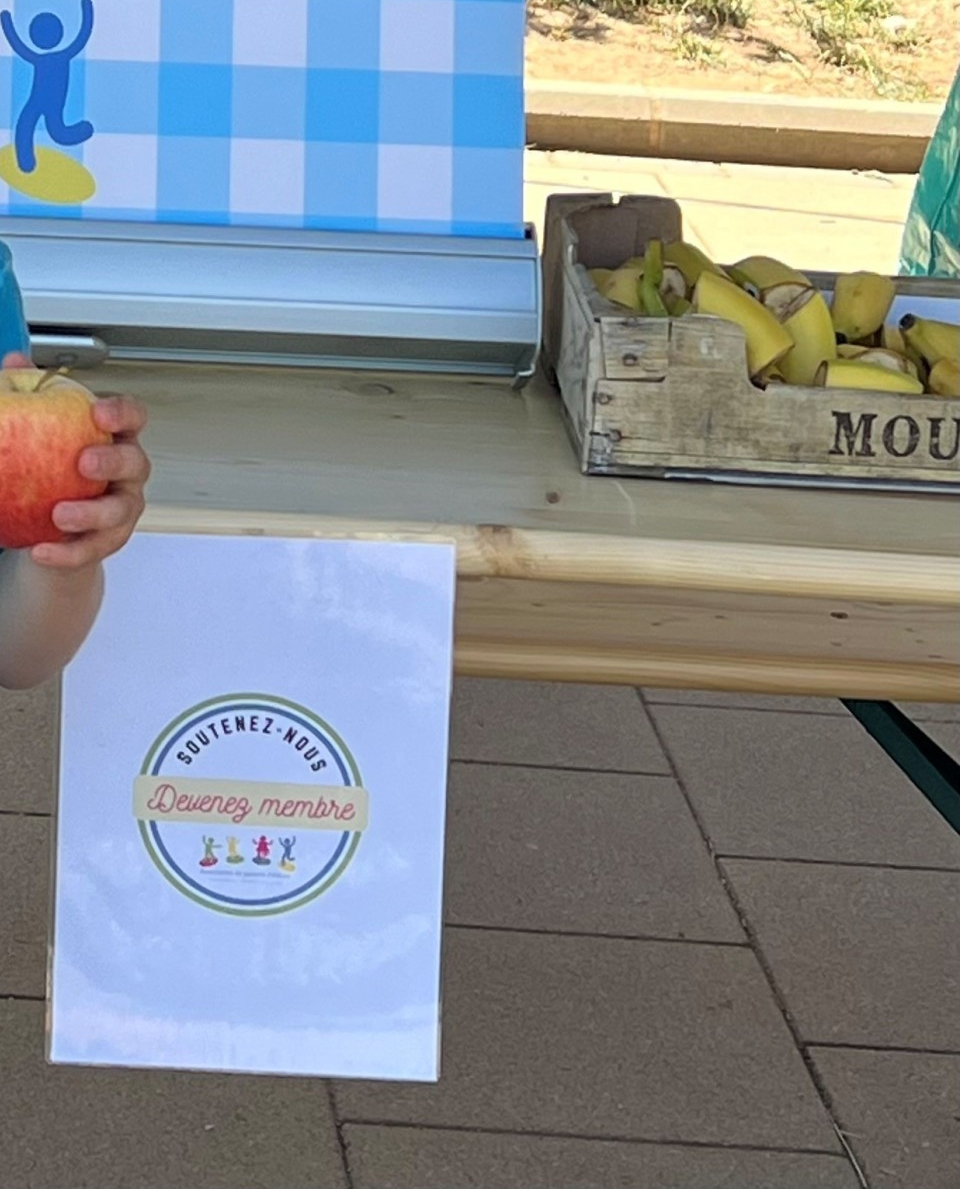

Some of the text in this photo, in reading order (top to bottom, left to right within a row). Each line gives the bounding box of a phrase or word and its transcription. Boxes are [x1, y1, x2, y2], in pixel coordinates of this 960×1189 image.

[176, 715, 328, 773] SOUTENEZ-NOUS
[146, 783, 356, 824] Devenez membre
